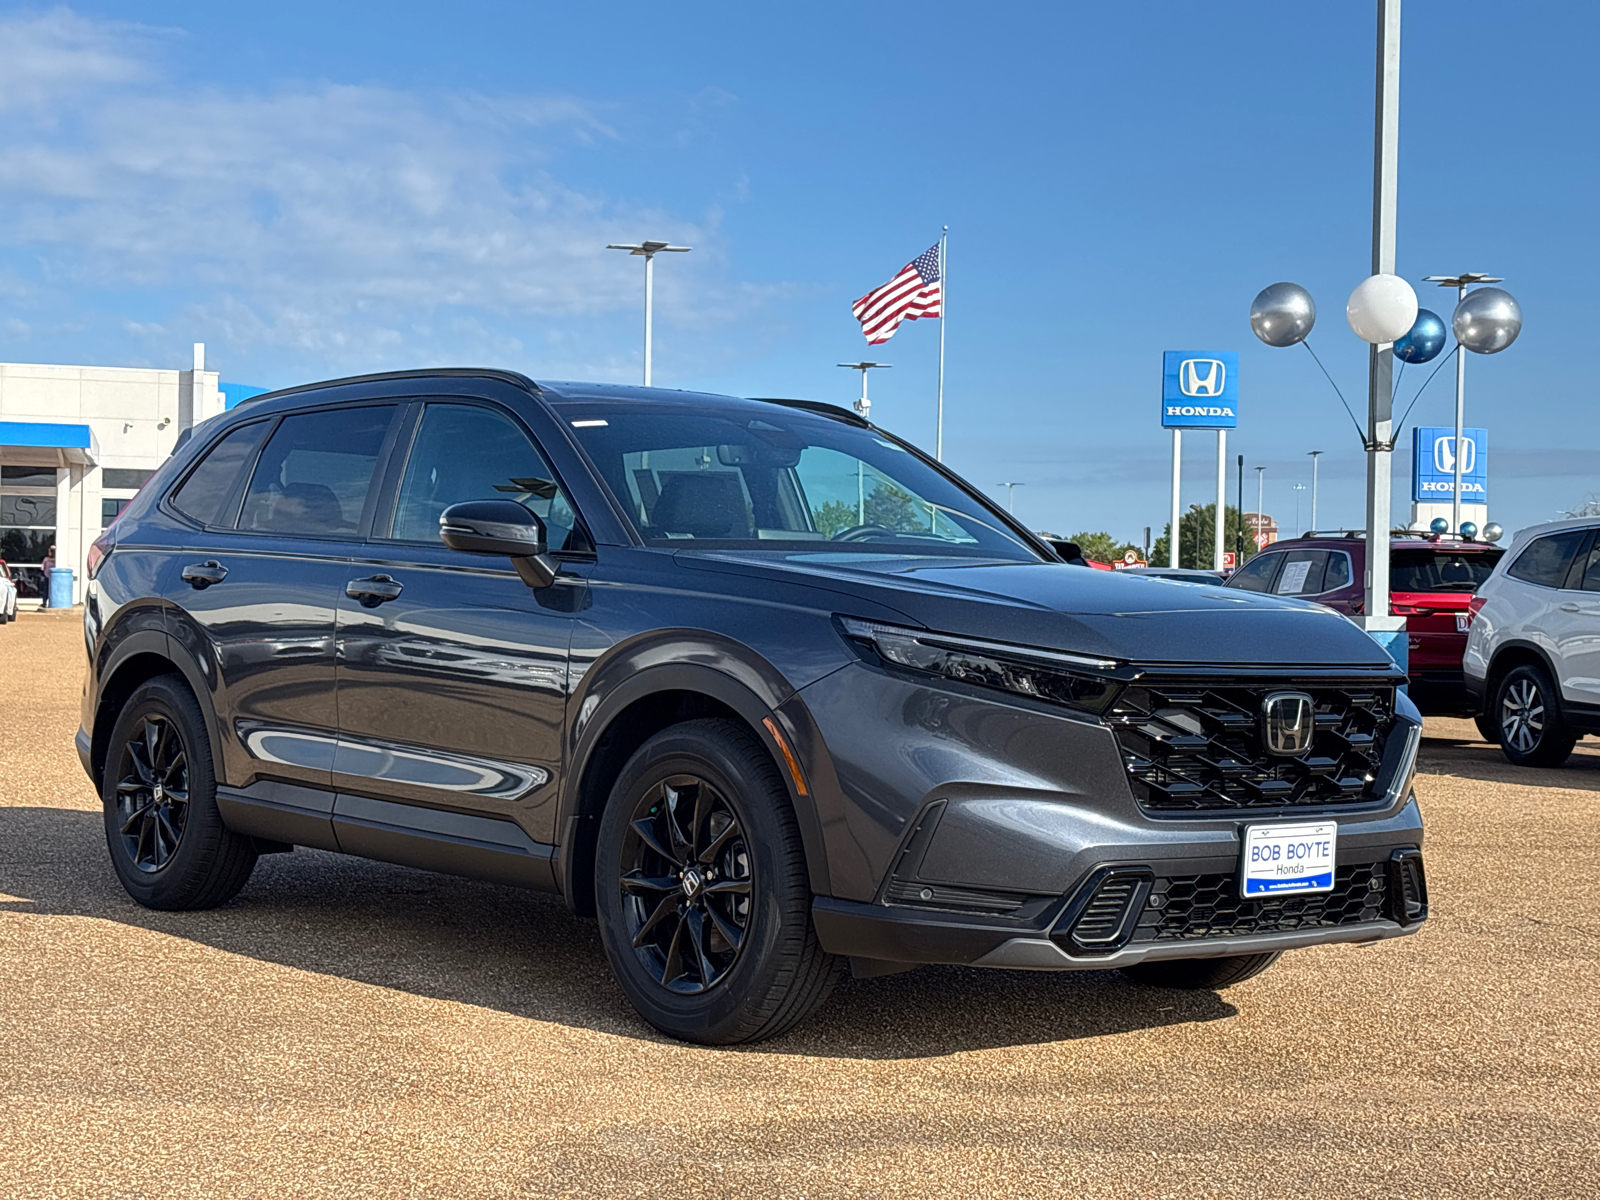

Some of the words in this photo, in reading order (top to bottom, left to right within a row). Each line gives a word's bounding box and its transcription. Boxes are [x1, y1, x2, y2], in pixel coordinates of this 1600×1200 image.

[1166, 406, 1235, 417] HONDA
[1251, 844, 1281, 862] BOB
[1287, 841, 1331, 860] BOYTE
[1276, 862, 1305, 876] Honda
